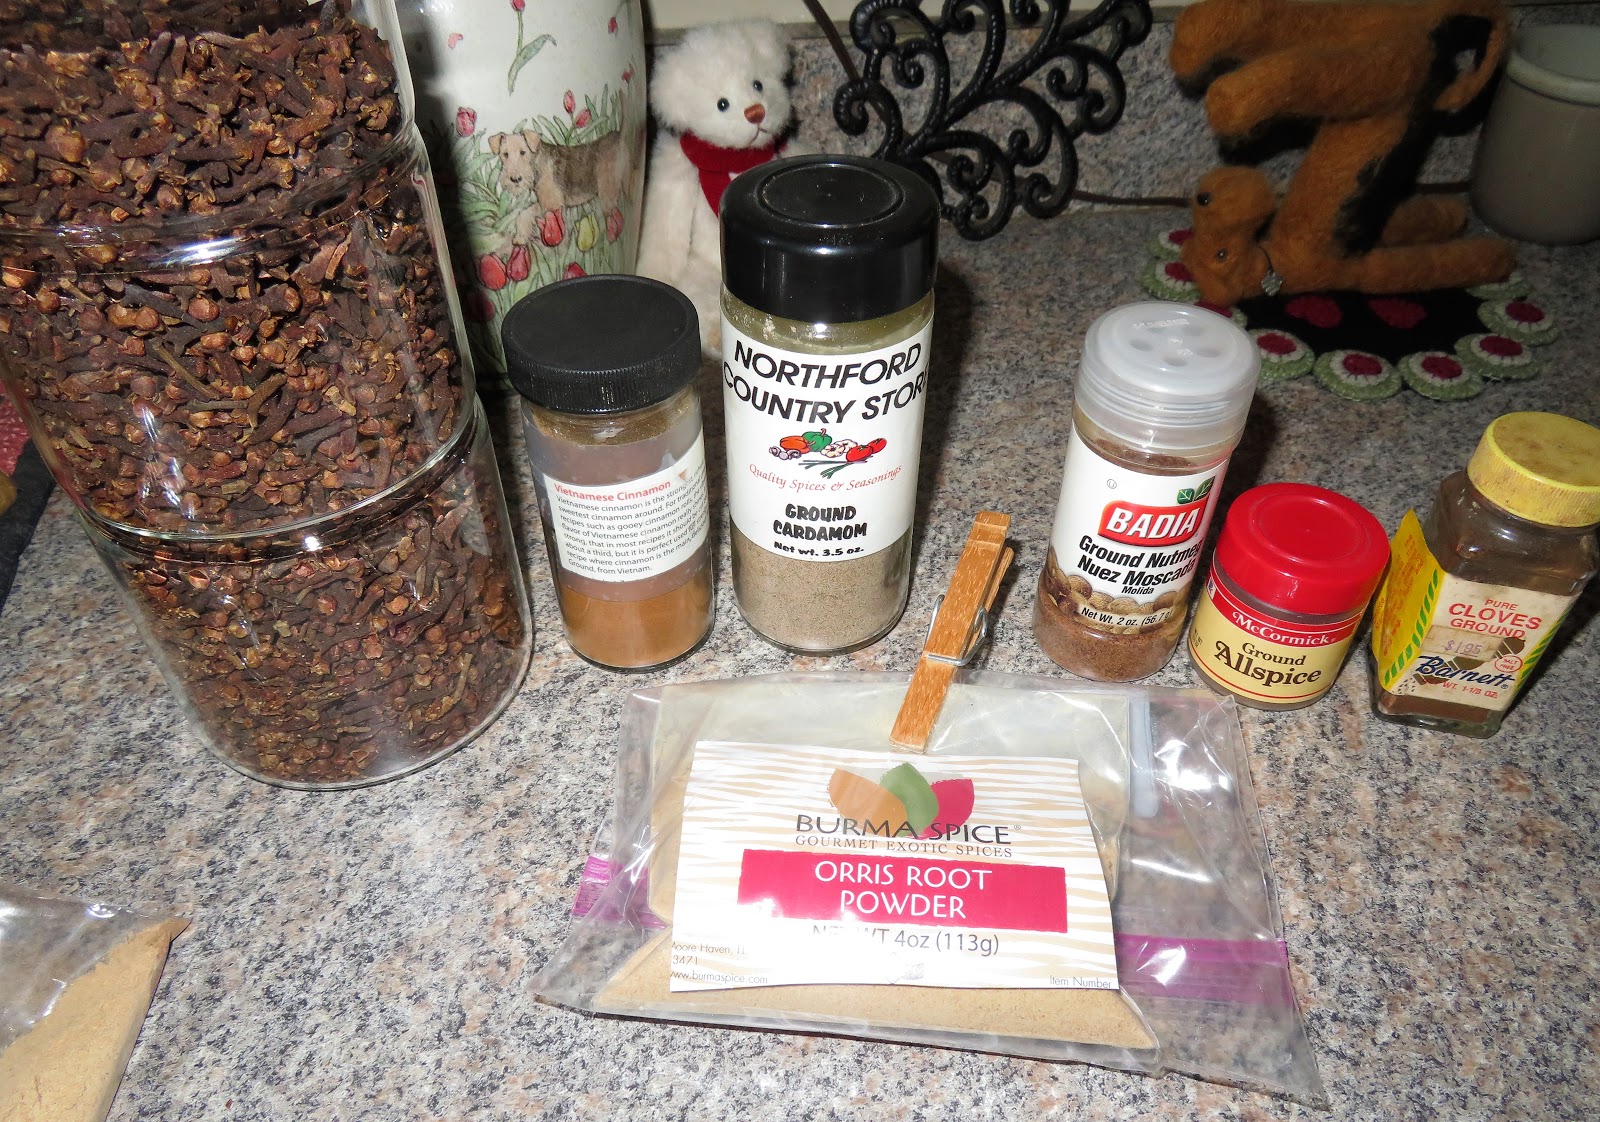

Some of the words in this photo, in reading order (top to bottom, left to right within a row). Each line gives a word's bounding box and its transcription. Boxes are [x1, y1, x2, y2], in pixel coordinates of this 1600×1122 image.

[734, 340, 922, 389] NORTHFORD
[723, 361, 856, 424] COUNTRY
[749, 463, 786, 490] Quality
[789, 479, 826, 493] Spices
[830, 482, 846, 492] &
[846, 464, 902, 491] Seasonings
[554, 483, 614, 502] Vietnamese
[617, 481, 671, 500] Cinnamon
[557, 495, 600, 512] Vietnamese
[601, 503, 643, 512] cinnamon
[645, 498, 651, 507] is
[652, 493, 665, 506] the
[558, 506, 590, 520] sweetest
[591, 511, 633, 521] cinnamon
[634, 503, 665, 519] around.
[665, 499, 676, 509] For
[560, 514, 585, 528] recipes
[586, 522, 605, 531] such
[617, 521, 643, 532] gooey
[644, 507, 680, 526] cinnamon
[785, 503, 857, 522] GROUND
[590, 530, 639, 540] Vietnamese
[639, 518, 677, 536] cinnamon
[773, 519, 868, 542] CARDAMOM
[1106, 507, 1200, 539] BADIA
[565, 542, 586, 554] about
[592, 550, 614, 558] third,
[646, 538, 673, 554] perfect
[673, 529, 688, 542] used
[588, 540, 605, 548] that
[638, 533, 666, 546] recipes
[773, 541, 795, 554] Net
[798, 548, 819, 557] wt.
[822, 548, 844, 557] 3.5
[846, 547, 865, 555] oz.
[1079, 535, 1146, 568] Ground
[566, 551, 588, 562] recipe
[588, 558, 613, 566] where
[614, 556, 655, 566] cinnamon
[663, 547, 675, 557] the
[568, 558, 596, 573] Ground,
[597, 566, 616, 574] from
[617, 566, 653, 575] Vietnam.
[1077, 555, 1122, 583] Nuez
[1122, 557, 1197, 587] Moscada
[1121, 585, 1155, 595] Molida
[1081, 606, 1098, 621] Net
[1098, 613, 1114, 625] Wt.
[1118, 617, 1126, 625] 2
[1125, 618, 1139, 627] oz.
[1141, 612, 1165, 627] (56.7
[1448, 602, 1542, 630] CLOVES
[1484, 599, 1518, 611] PURE
[1232, 611, 1329, 645] McCormick
[1450, 618, 1526, 640] GROUND
[1214, 640, 1322, 687] Allspice
[1242, 642, 1307, 666] Ground
[1415, 655, 1516, 687] Barnett
[1442, 681, 1458, 690] WT.
[796, 814, 919, 839] BURMA
[929, 822, 1012, 845] SPICE
[795, 835, 879, 850] GOURMET
[886, 841, 948, 854] EXOTIC
[955, 844, 1013, 858] SPICES
[814, 860, 894, 886] ORRIS
[907, 866, 993, 891] ROOT
[839, 890, 967, 919] POWDER
[700, 942, 733, 955] Haven,
[893, 930, 930, 949] 4oz
[935, 930, 1000, 957] (113g)
[672, 954, 699, 965] 3471
[1050, 975, 1069, 986] Item
[1073, 976, 1112, 989] Number
